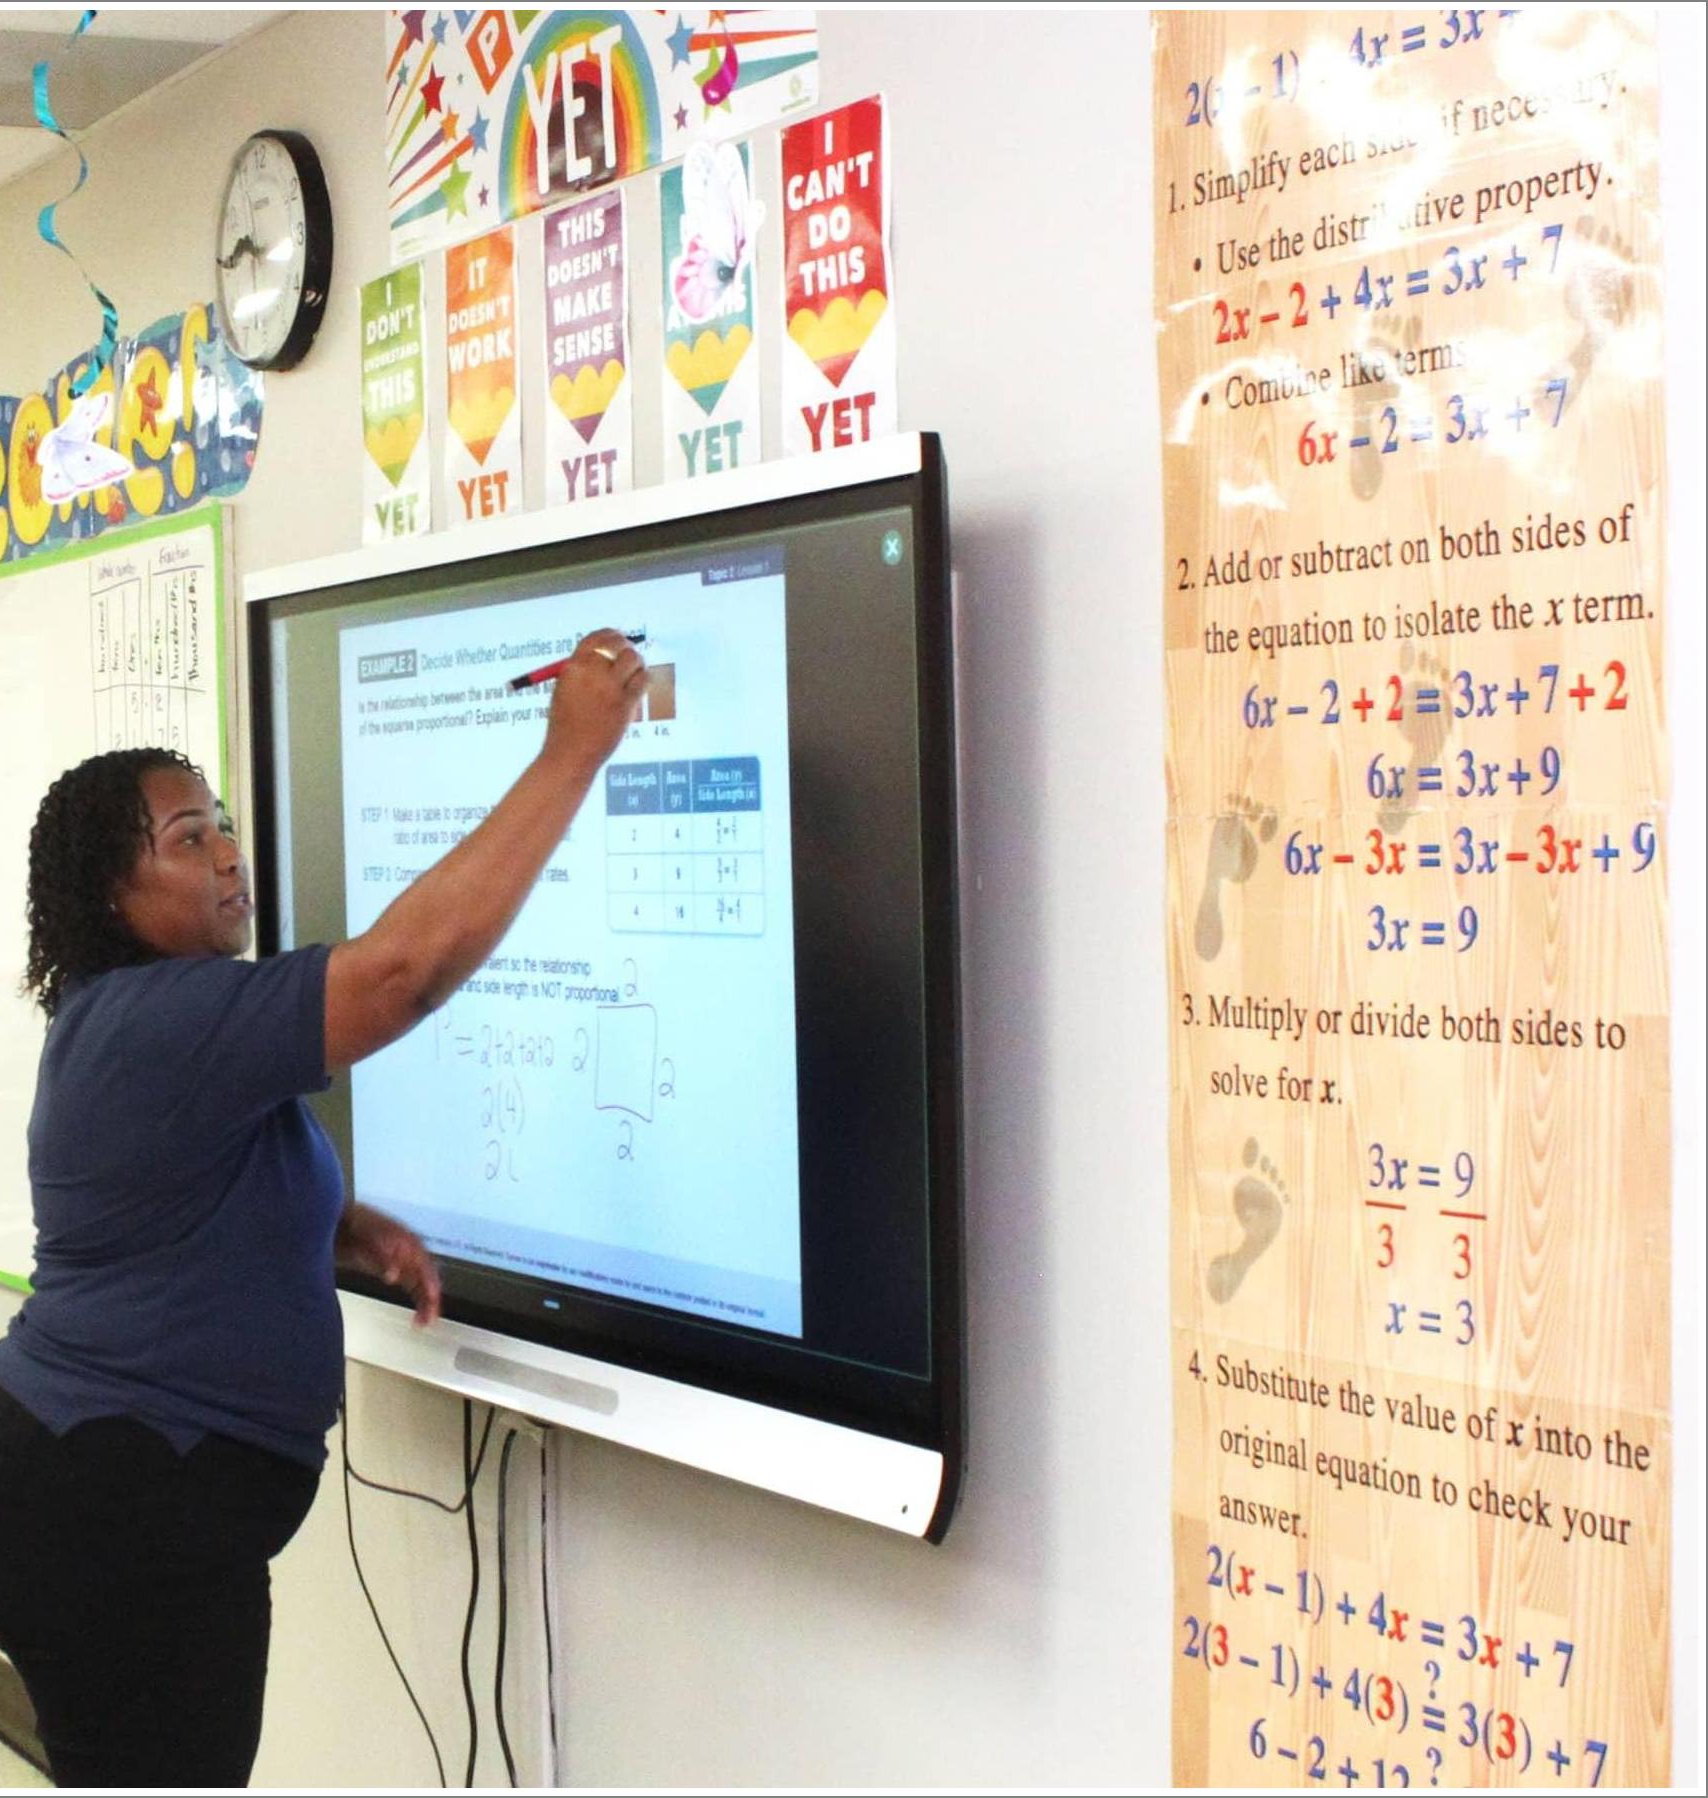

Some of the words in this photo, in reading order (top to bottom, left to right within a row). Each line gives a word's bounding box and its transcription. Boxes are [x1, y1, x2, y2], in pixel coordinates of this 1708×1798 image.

[477, 16, 500, 76] P
[522, 25, 622, 194] YET
[824, 121, 833, 155] I
[1194, 150, 1291, 206] Simplify
[1299, 132, 1356, 177] each
[1442, 101, 1464, 131] if
[788, 152, 873, 211] CAN'T
[558, 208, 605, 249] THIS
[808, 206, 851, 250] DO
[1216, 238, 1260, 275] Use
[1269, 233, 1304, 267] the
[1475, 159, 1613, 224] property.
[468, 258, 488, 292] IT
[548, 244, 618, 288] DOESN'T
[800, 247, 865, 296] THIS
[1215, 298, 1251, 344] 2x
[1289, 281, 1308, 328] 2
[1354, 266, 1394, 312] 4x
[1442, 246, 1488, 296] 3x
[1542, 224, 1564, 275] 7
[366, 305, 414, 345] DON'T
[449, 295, 510, 334] DOESN'T
[553, 282, 612, 326] MAKE
[449, 328, 512, 373] WORK
[553, 323, 614, 366] SENSE
[368, 370, 415, 412] THIS
[1341, 351, 1387, 388] like
[801, 391, 876, 452] YET
[678, 421, 743, 479] YET
[457, 470, 508, 520] YET
[561, 449, 617, 502] YET
[375, 492, 419, 536] YET
[1177, 557, 1196, 590] 2.
[1202, 550, 1252, 588] Add
[1259, 555, 1283, 580] or
[1291, 538, 1393, 579] subtract
[1400, 538, 1431, 566] on
[1440, 519, 1501, 562] both
[1511, 511, 1586, 553] sides
[1598, 503, 1636, 545] of
[1204, 622, 1240, 655] the
[1248, 614, 1354, 660] equation
[1363, 609, 1387, 642] to
[1394, 602, 1481, 639] isolate
[1491, 594, 1533, 630] the
[1543, 598, 1565, 627] x
[1573, 591, 1655, 624] term.
[361, 654, 406, 676] EXAMPLE
[476, 708, 508, 726] Explain
[1367, 905, 1410, 953] 3x
[1457, 905, 1479, 953] 9
[542, 981, 561, 998] NOT
[1182, 993, 1201, 1027] 3.
[1208, 994, 1308, 1042] Multiply
[1316, 1006, 1343, 1035] or
[1350, 1000, 1431, 1039] divide
[1440, 1006, 1502, 1045] both
[1512, 1012, 1585, 1048] sides
[1595, 1018, 1626, 1051] to
[1210, 1063, 1269, 1099] solve
[1277, 1066, 1314, 1103] for
[1319, 1077, 1344, 1106] x.
[1367, 1142, 1408, 1192] 3x
[1453, 1151, 1475, 1199] 9
[1384, 1300, 1407, 1336] x
[1454, 1299, 1476, 1346] 3
[1188, 1349, 1208, 1384] 4.
[1216, 1353, 1331, 1410] Substitute
[1339, 1380, 1376, 1419] the
[1385, 1394, 1456, 1435] value
[1467, 1406, 1499, 1443] of
[1505, 1419, 1526, 1448] x
[1534, 1420, 1592, 1461] into
[1604, 1429, 1651, 1473] the
[1220, 1424, 1308, 1473] original
[1315, 1449, 1422, 1499] equation
[1432, 1472, 1459, 1507] to
[1468, 1479, 1553, 1529] check
[1562, 1501, 1632, 1547] your
[1219, 1493, 1308, 1540] answer.
